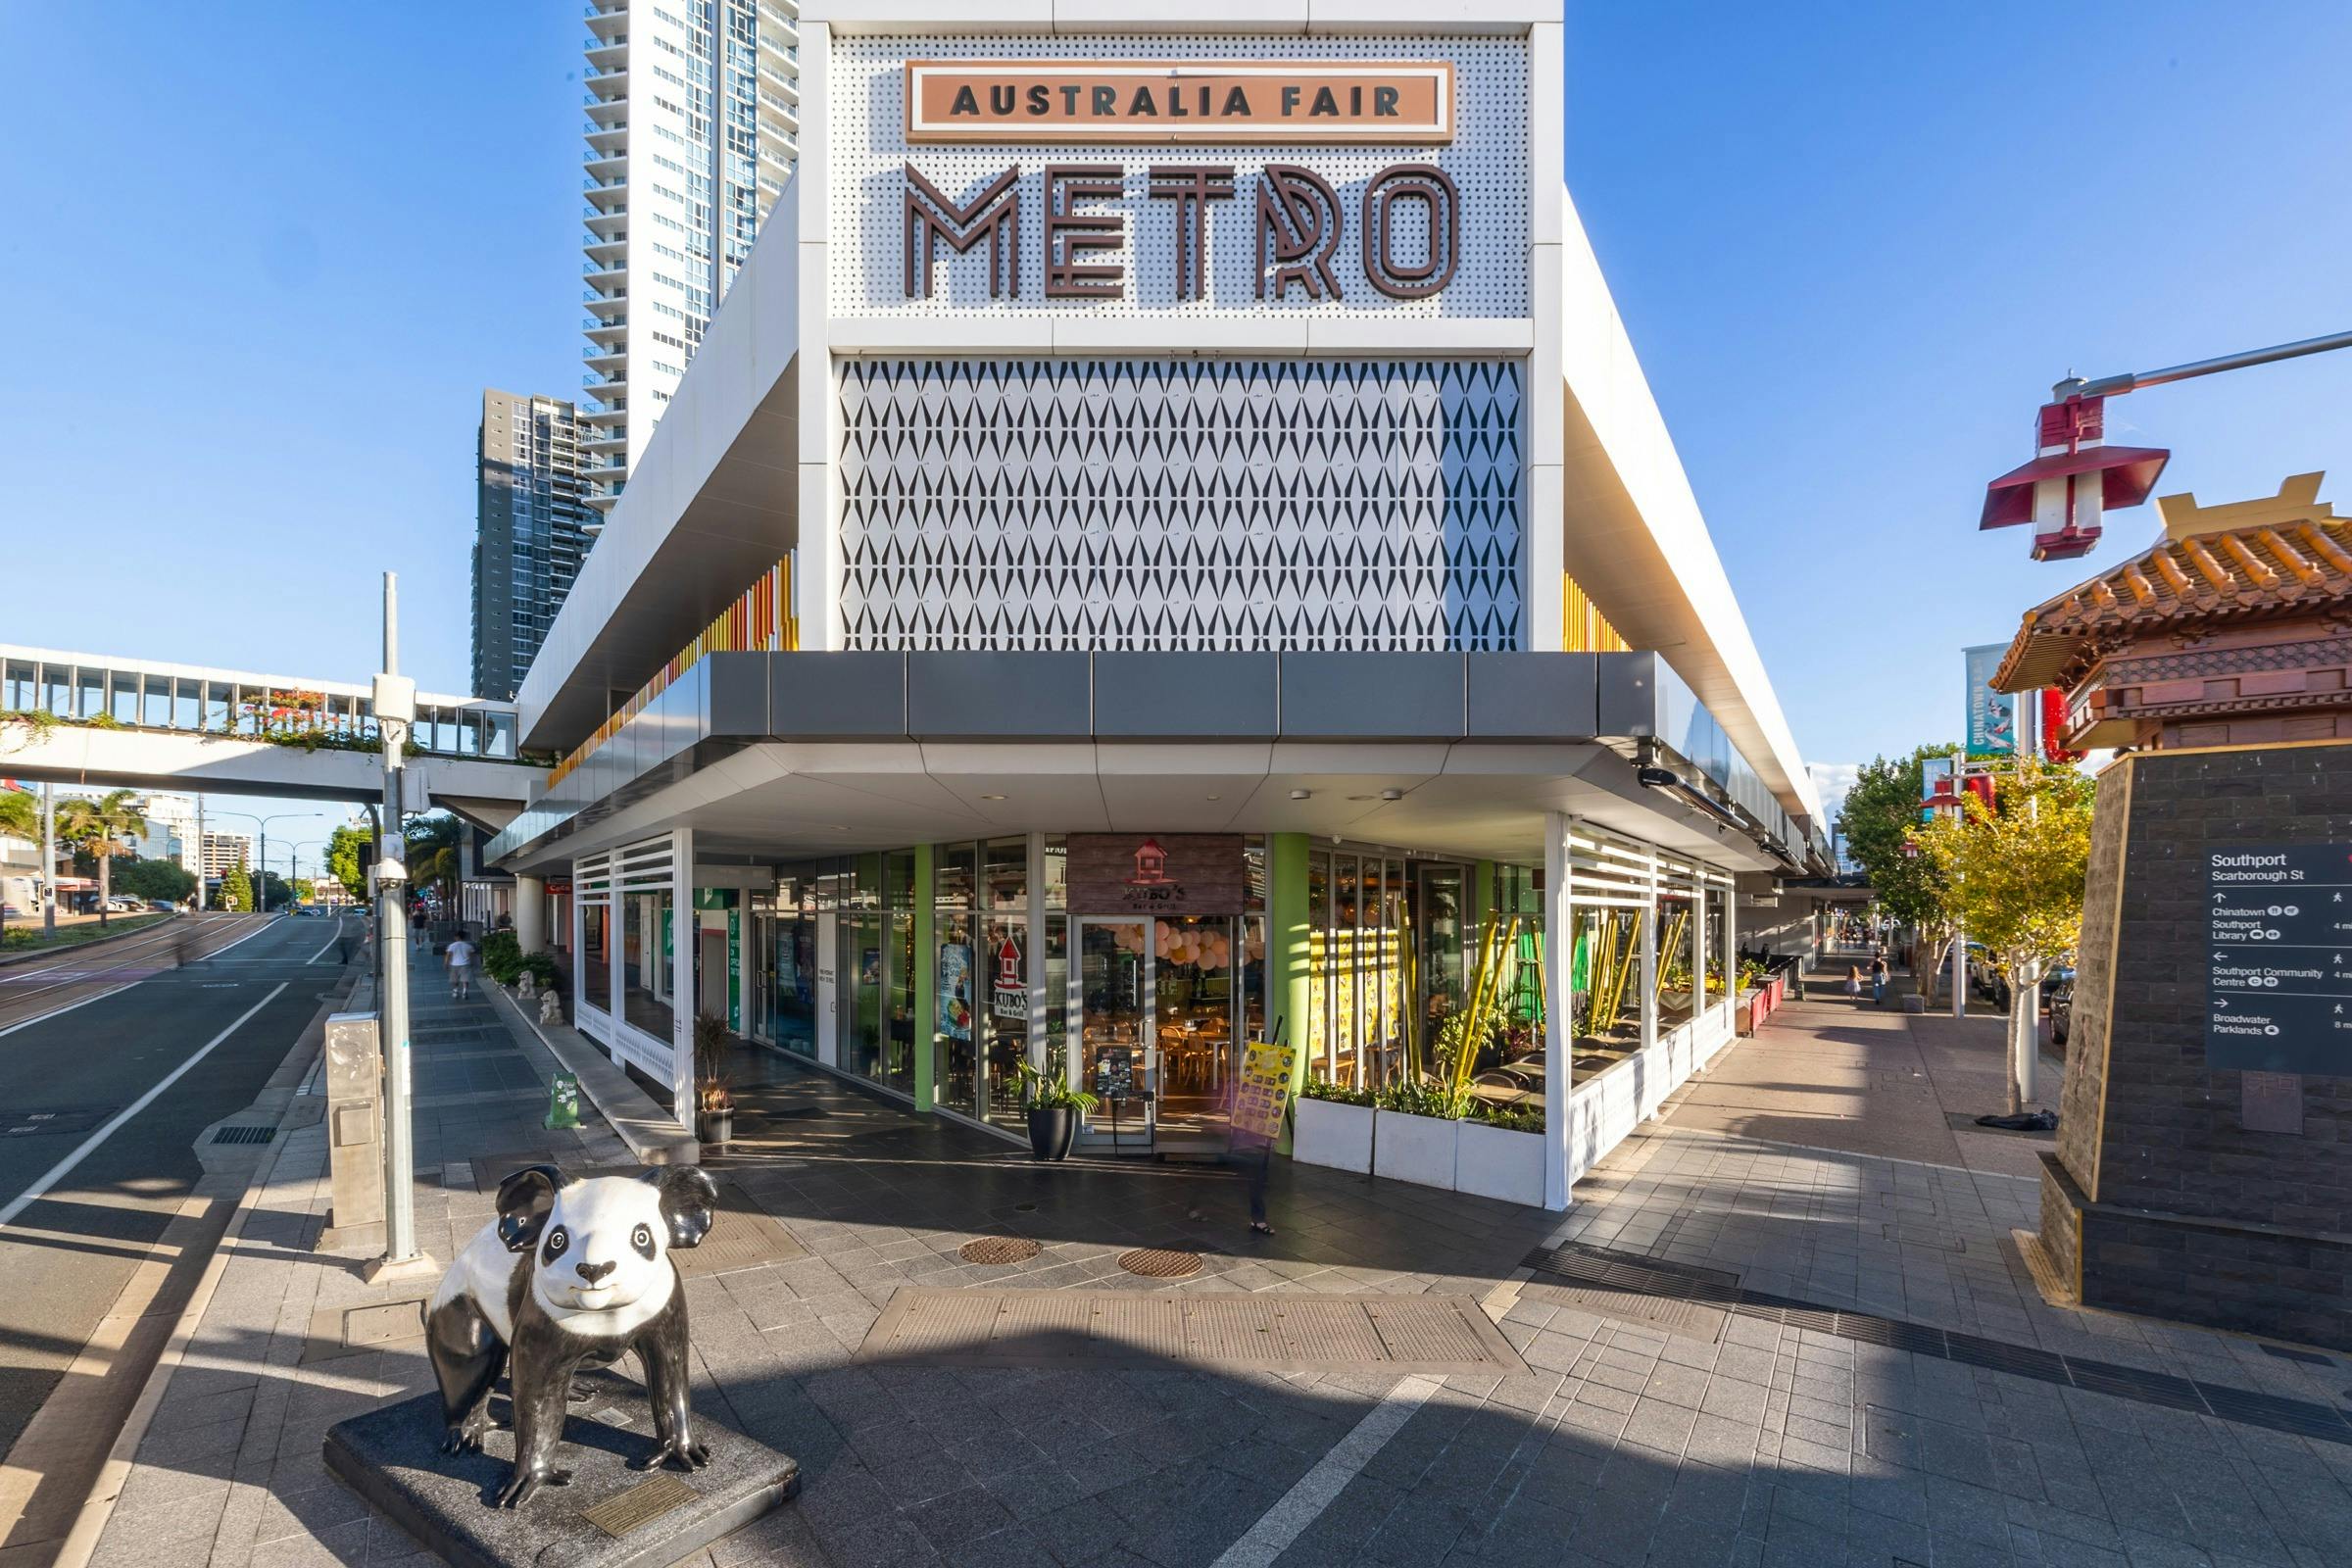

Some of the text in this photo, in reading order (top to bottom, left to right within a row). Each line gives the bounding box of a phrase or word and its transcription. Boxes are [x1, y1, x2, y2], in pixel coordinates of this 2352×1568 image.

[950, 84, 1400, 117] AUSTRALIA FAIR
[905, 160, 1459, 300] METRO
[1973, 685, 1984, 745] CHINATOWN
[2211, 854, 2287, 868] Southport
[2211, 869, 2305, 882] Scarborough St
[2212, 907, 2266, 916] Chinatown
[2212, 920, 2262, 930] Southport
[2212, 931, 2247, 941] Library
[2212, 966, 2324, 979] Southport Community
[2213, 977, 2246, 987] Centre
[2213, 1013, 2272, 1024] Broadwater
[2213, 1024, 2263, 1036] Parklands
